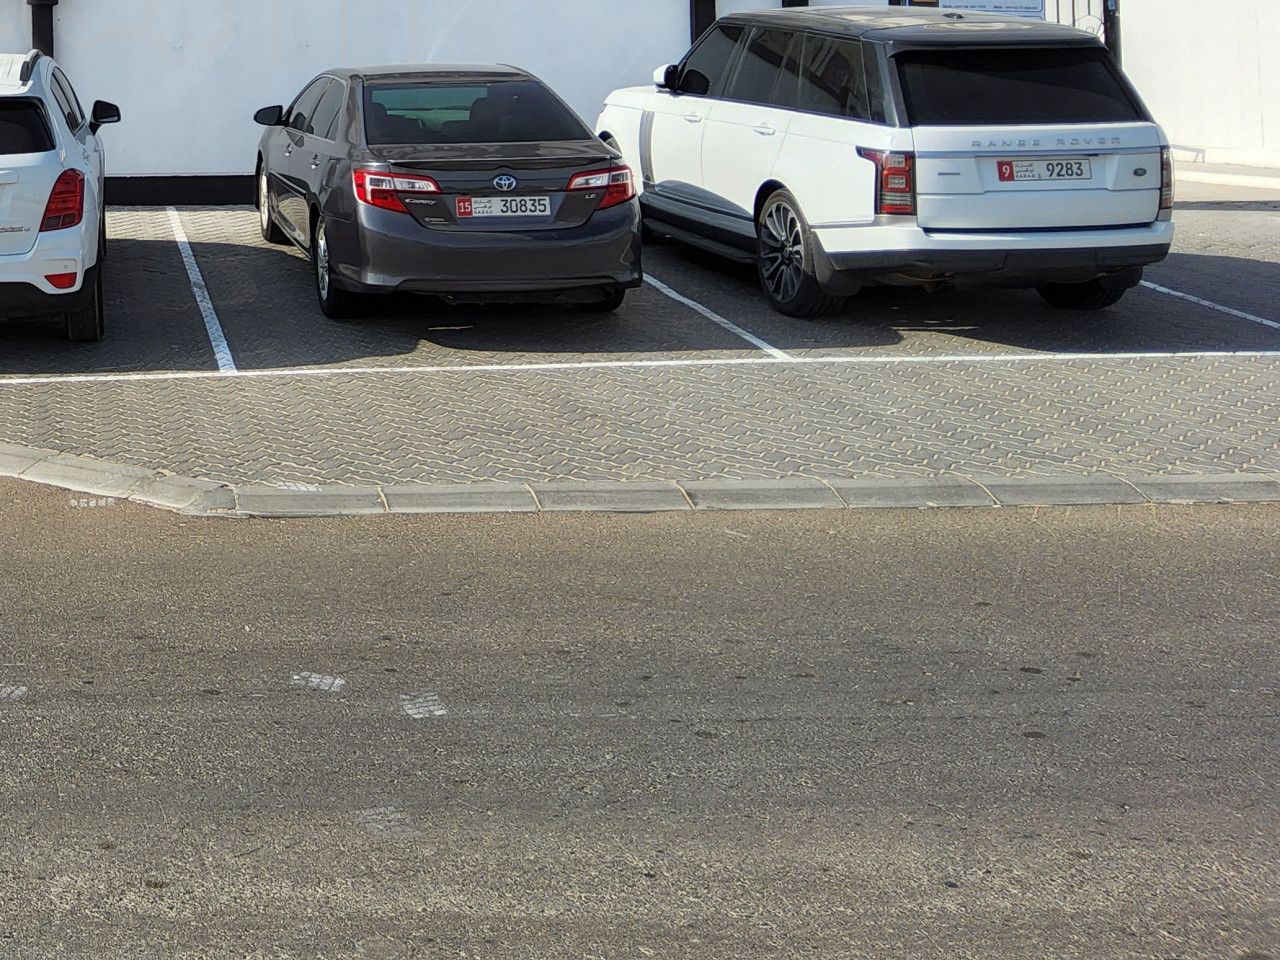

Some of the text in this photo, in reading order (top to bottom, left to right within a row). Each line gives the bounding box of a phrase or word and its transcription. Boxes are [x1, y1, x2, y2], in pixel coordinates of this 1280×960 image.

[1002, 165, 1010, 177] 9
[1046, 162, 1083, 177] 9283
[459, 202, 471, 212] 15
[500, 198, 547, 213] 30835
